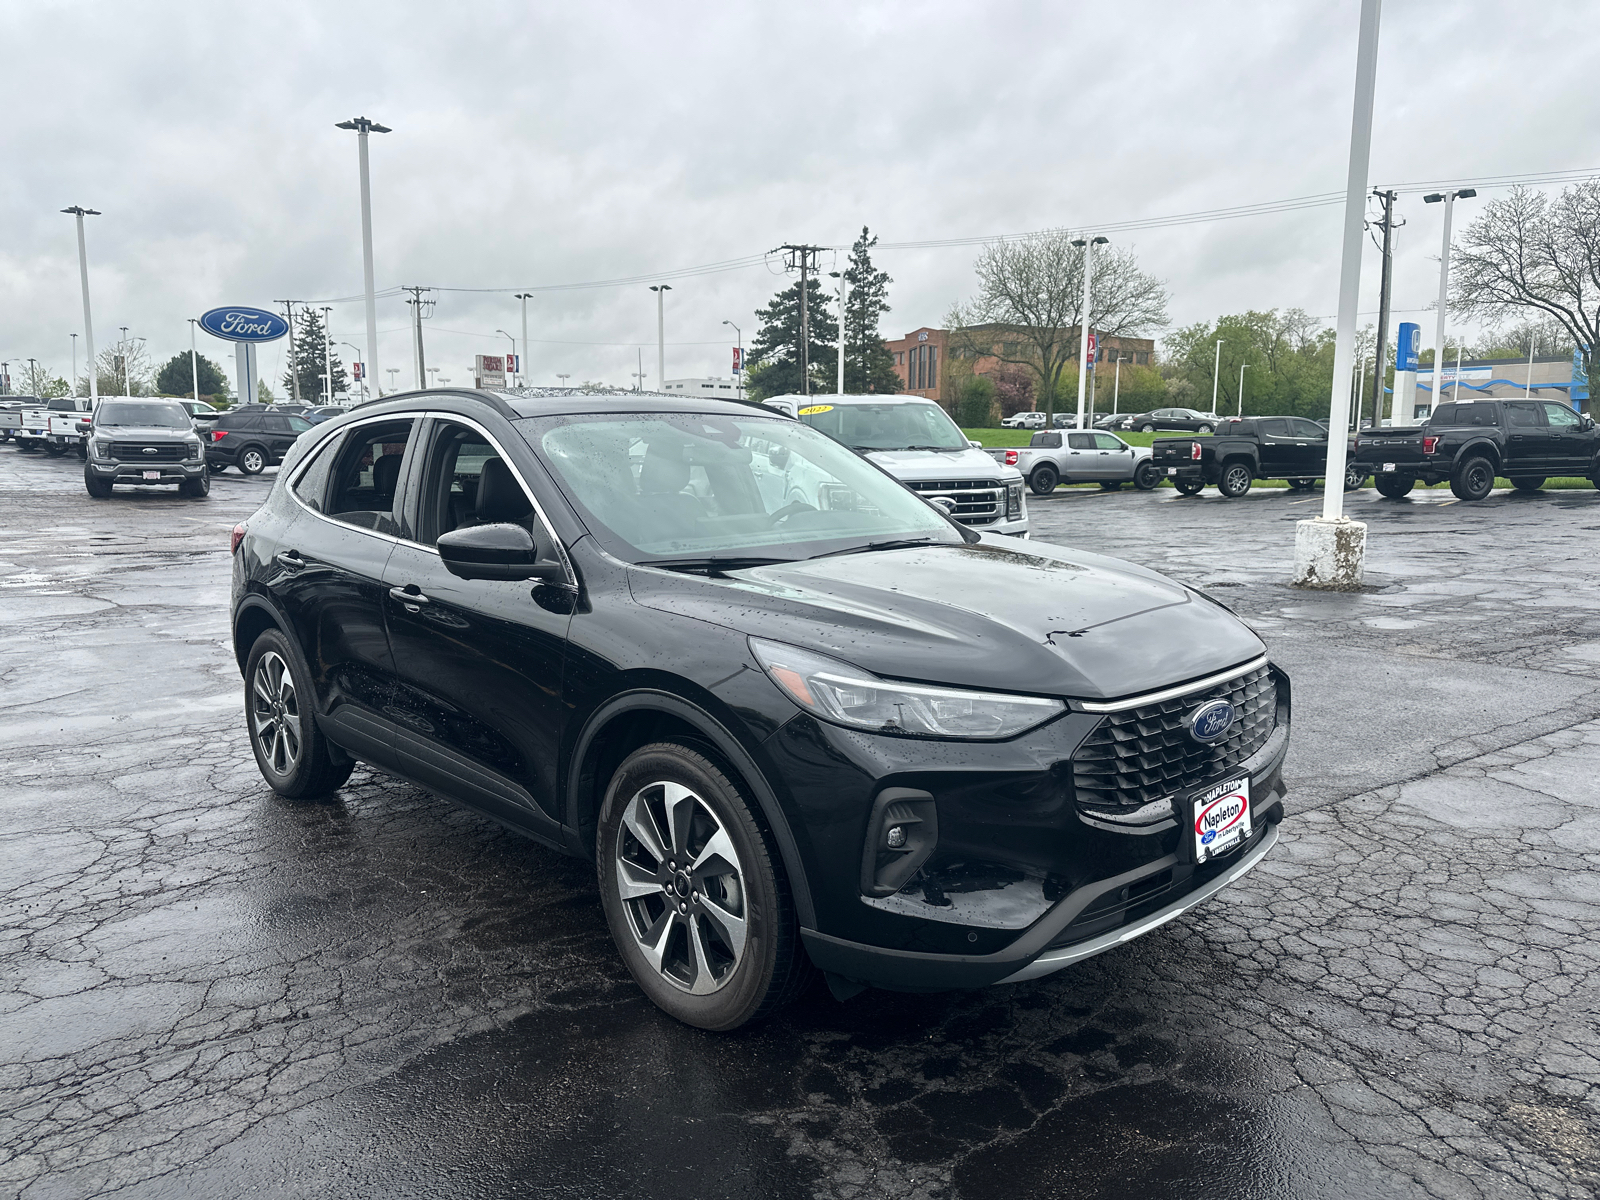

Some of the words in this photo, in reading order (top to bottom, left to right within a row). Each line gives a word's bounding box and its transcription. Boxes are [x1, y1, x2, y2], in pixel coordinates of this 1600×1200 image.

[221, 312, 272, 335] Ford
[804, 406, 827, 415] 2022
[1204, 708, 1229, 735] Ford
[1207, 780, 1239, 803] NAPLETON
[1204, 804, 1239, 830] Napleton
[1222, 821, 1245, 837] Libertyville
[1212, 836, 1240, 856] LIBERTYVILLE
